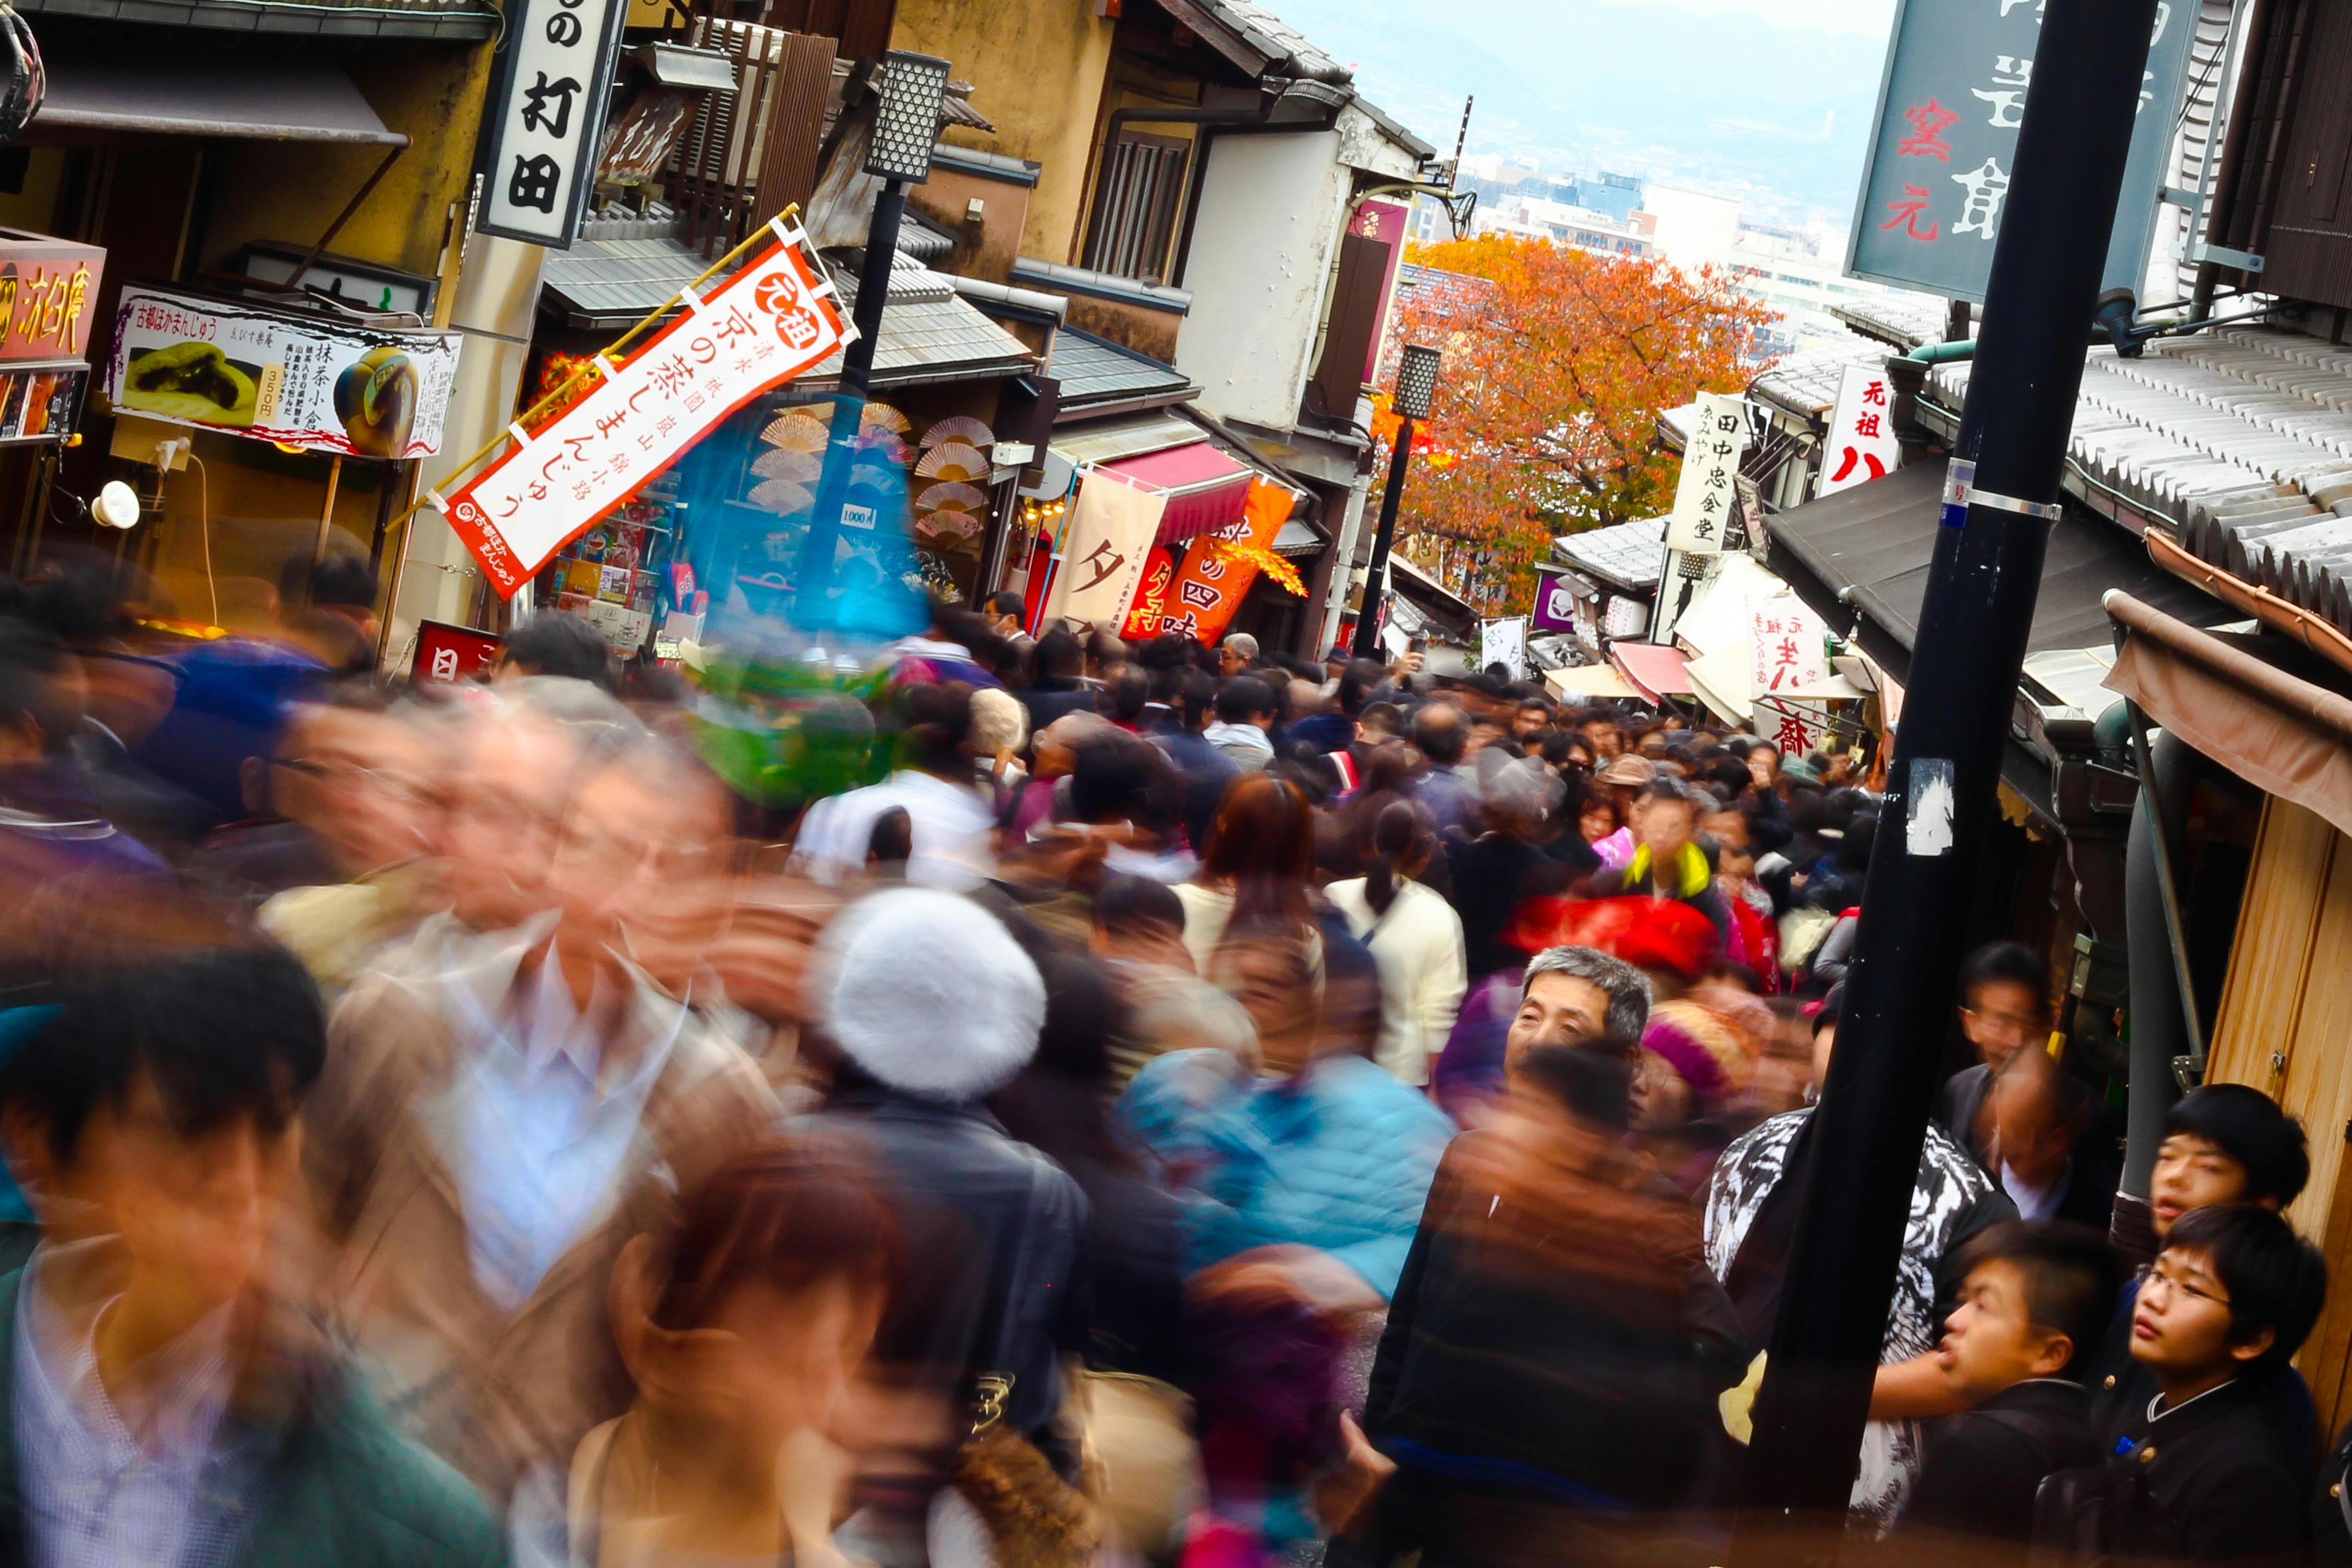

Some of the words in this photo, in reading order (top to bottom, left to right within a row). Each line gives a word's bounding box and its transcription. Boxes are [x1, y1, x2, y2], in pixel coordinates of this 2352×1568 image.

[509, 0, 584, 214] の打田
[1878, 96, 1960, 241] 窯元
[137, 303, 217, 341] 古都ほかまんじゅう
[757, 274, 818, 347] 元祖
[734, 340, 774, 375] 清水
[260, 371, 277, 417] 350円
[304, 342, 334, 431] 抹茶小倉
[496, 304, 757, 518] 京の蒸しまんじゅう
[1855, 381, 1886, 439] 元祖
[636, 415, 679, 453] 嵐山
[571, 452, 629, 502] 錦小路
[474, 513, 508, 557] 古都ほか
[478, 541, 516, 586] まんじゅう
